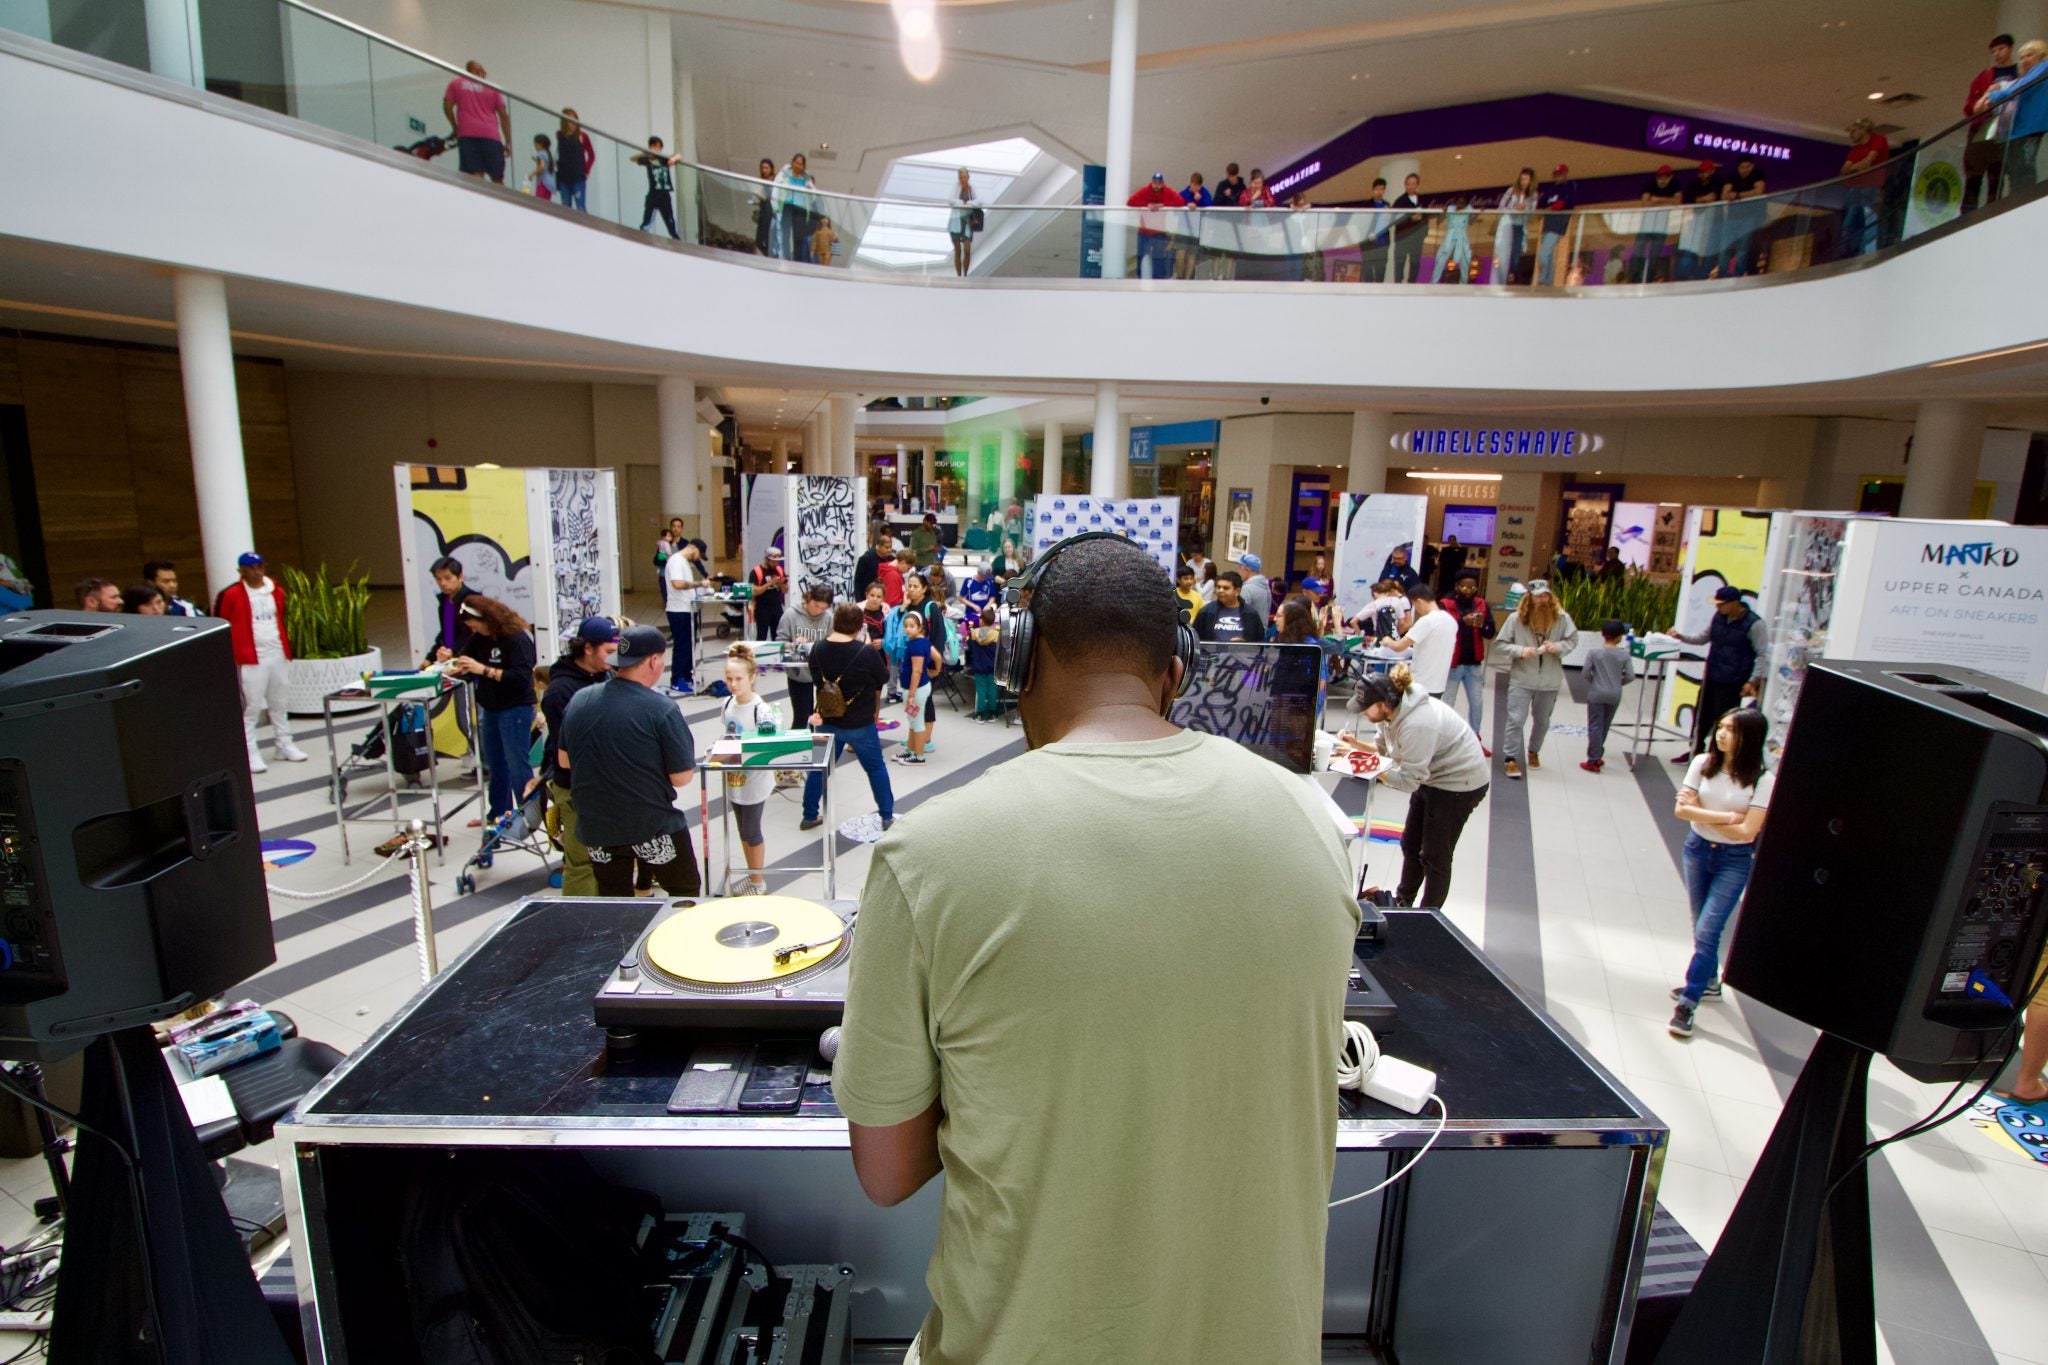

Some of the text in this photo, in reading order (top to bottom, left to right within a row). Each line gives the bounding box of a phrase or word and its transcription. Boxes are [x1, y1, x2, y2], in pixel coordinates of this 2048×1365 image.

[1693, 132, 1792, 161] CHOCOLATIER
[1269, 160, 1322, 196] OCOLATIER
[1412, 429, 1577, 457] WIRELESSWAVE
[1884, 580, 2045, 601] UPPER CANADA
[1888, 604, 2039, 625] ART ON SNEAKERS
